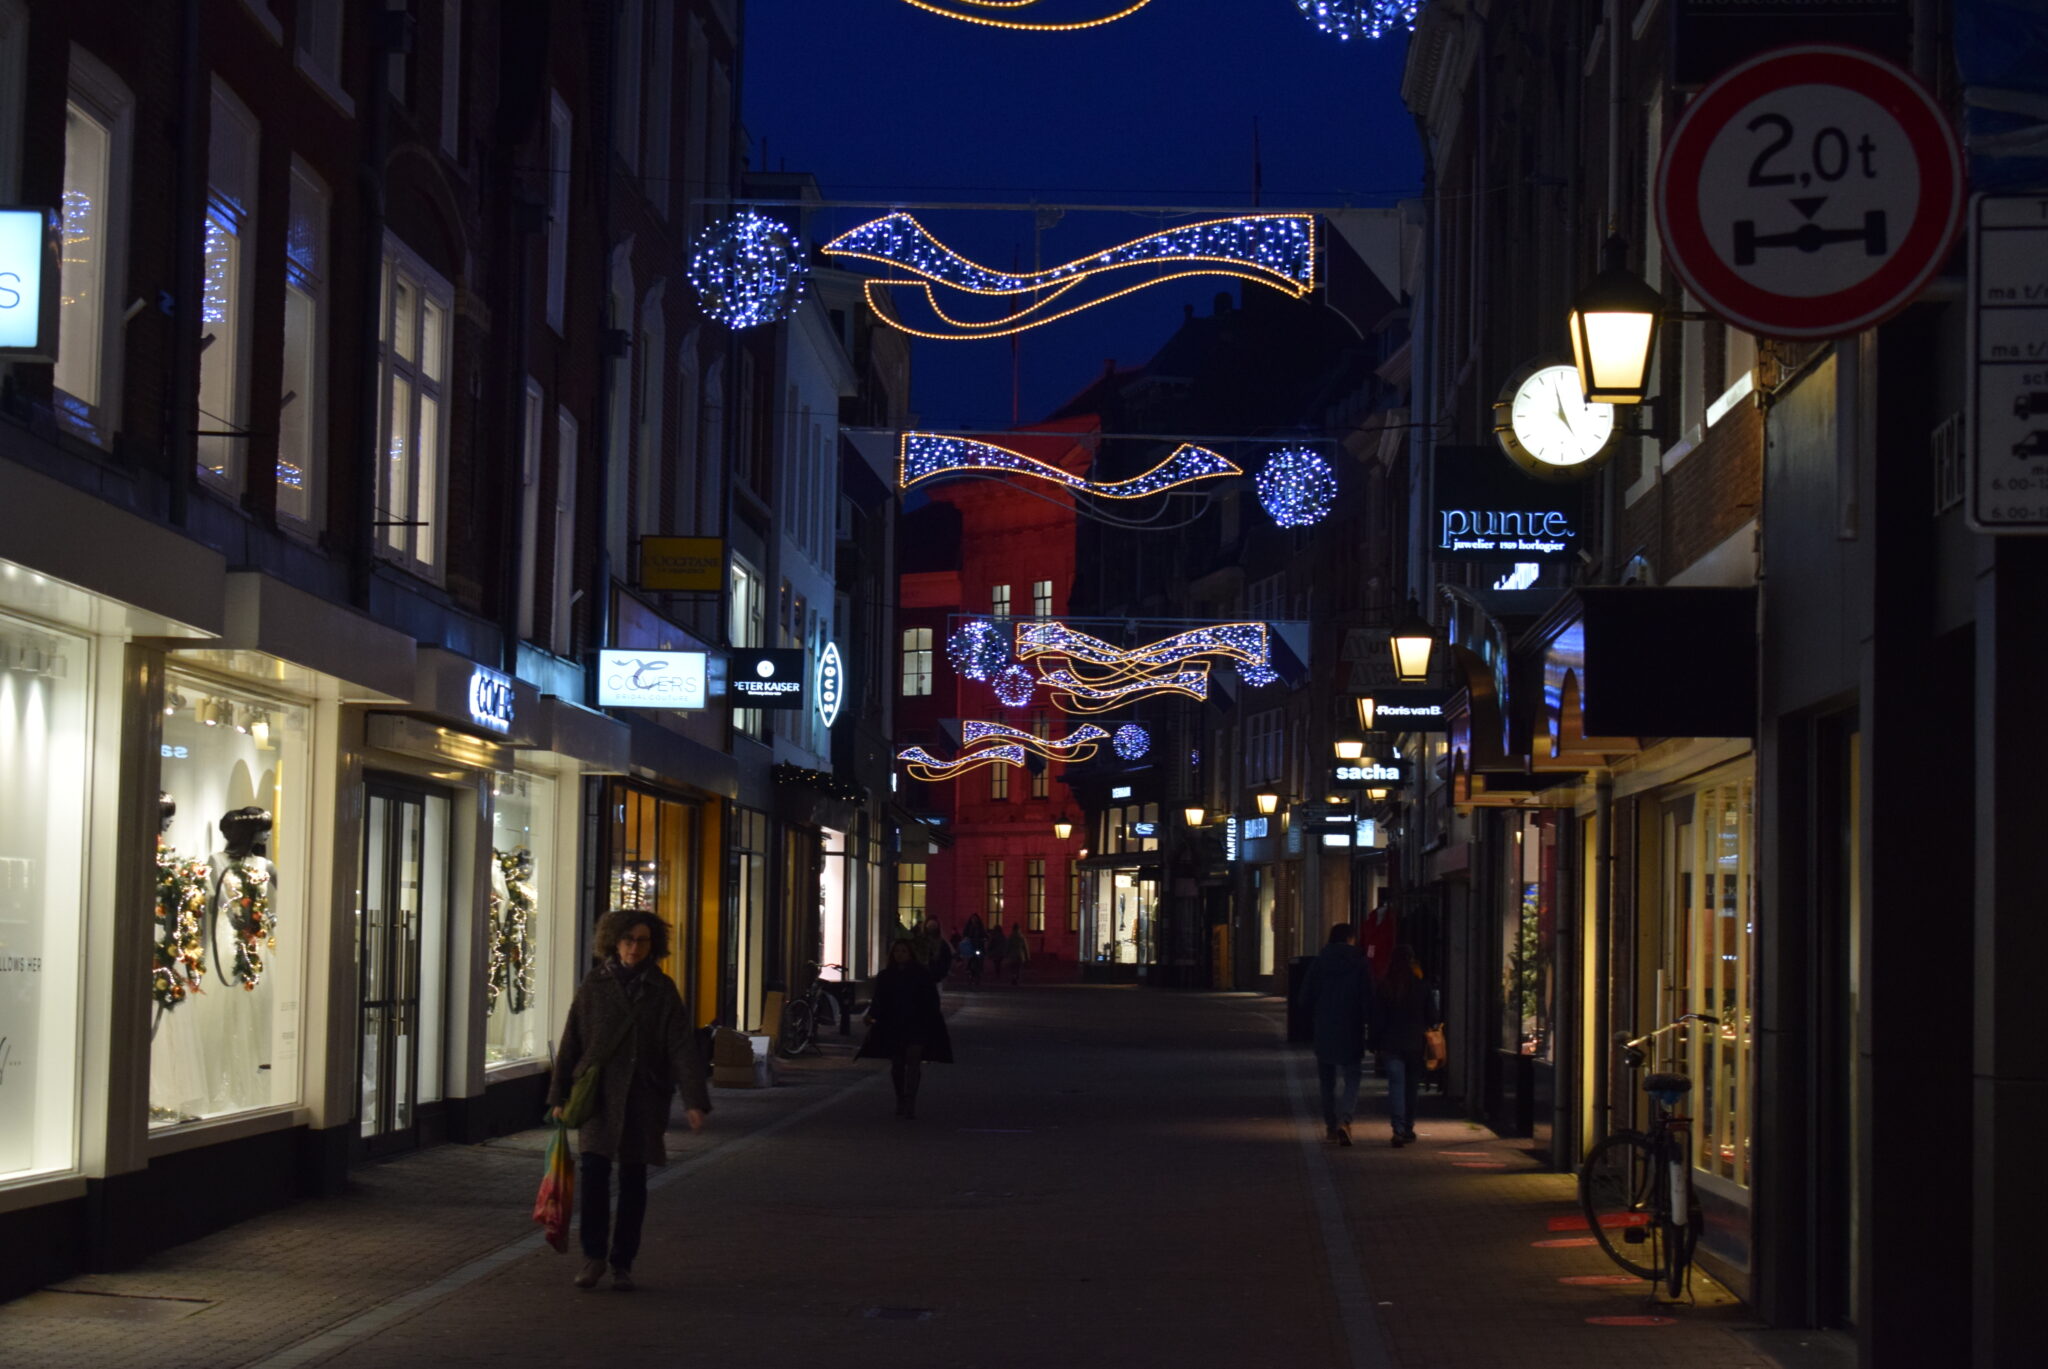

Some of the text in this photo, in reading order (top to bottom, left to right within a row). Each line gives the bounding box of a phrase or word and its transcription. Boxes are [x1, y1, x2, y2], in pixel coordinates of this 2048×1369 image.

[1453, 538, 1496, 552] juwelier
[1518, 539, 1566, 553] horlogier
[607, 674, 697, 693] COVERS
[763, 682, 800, 692] KAISER
[1410, 707, 1430, 716] van
[1335, 763, 1400, 780] sacha
